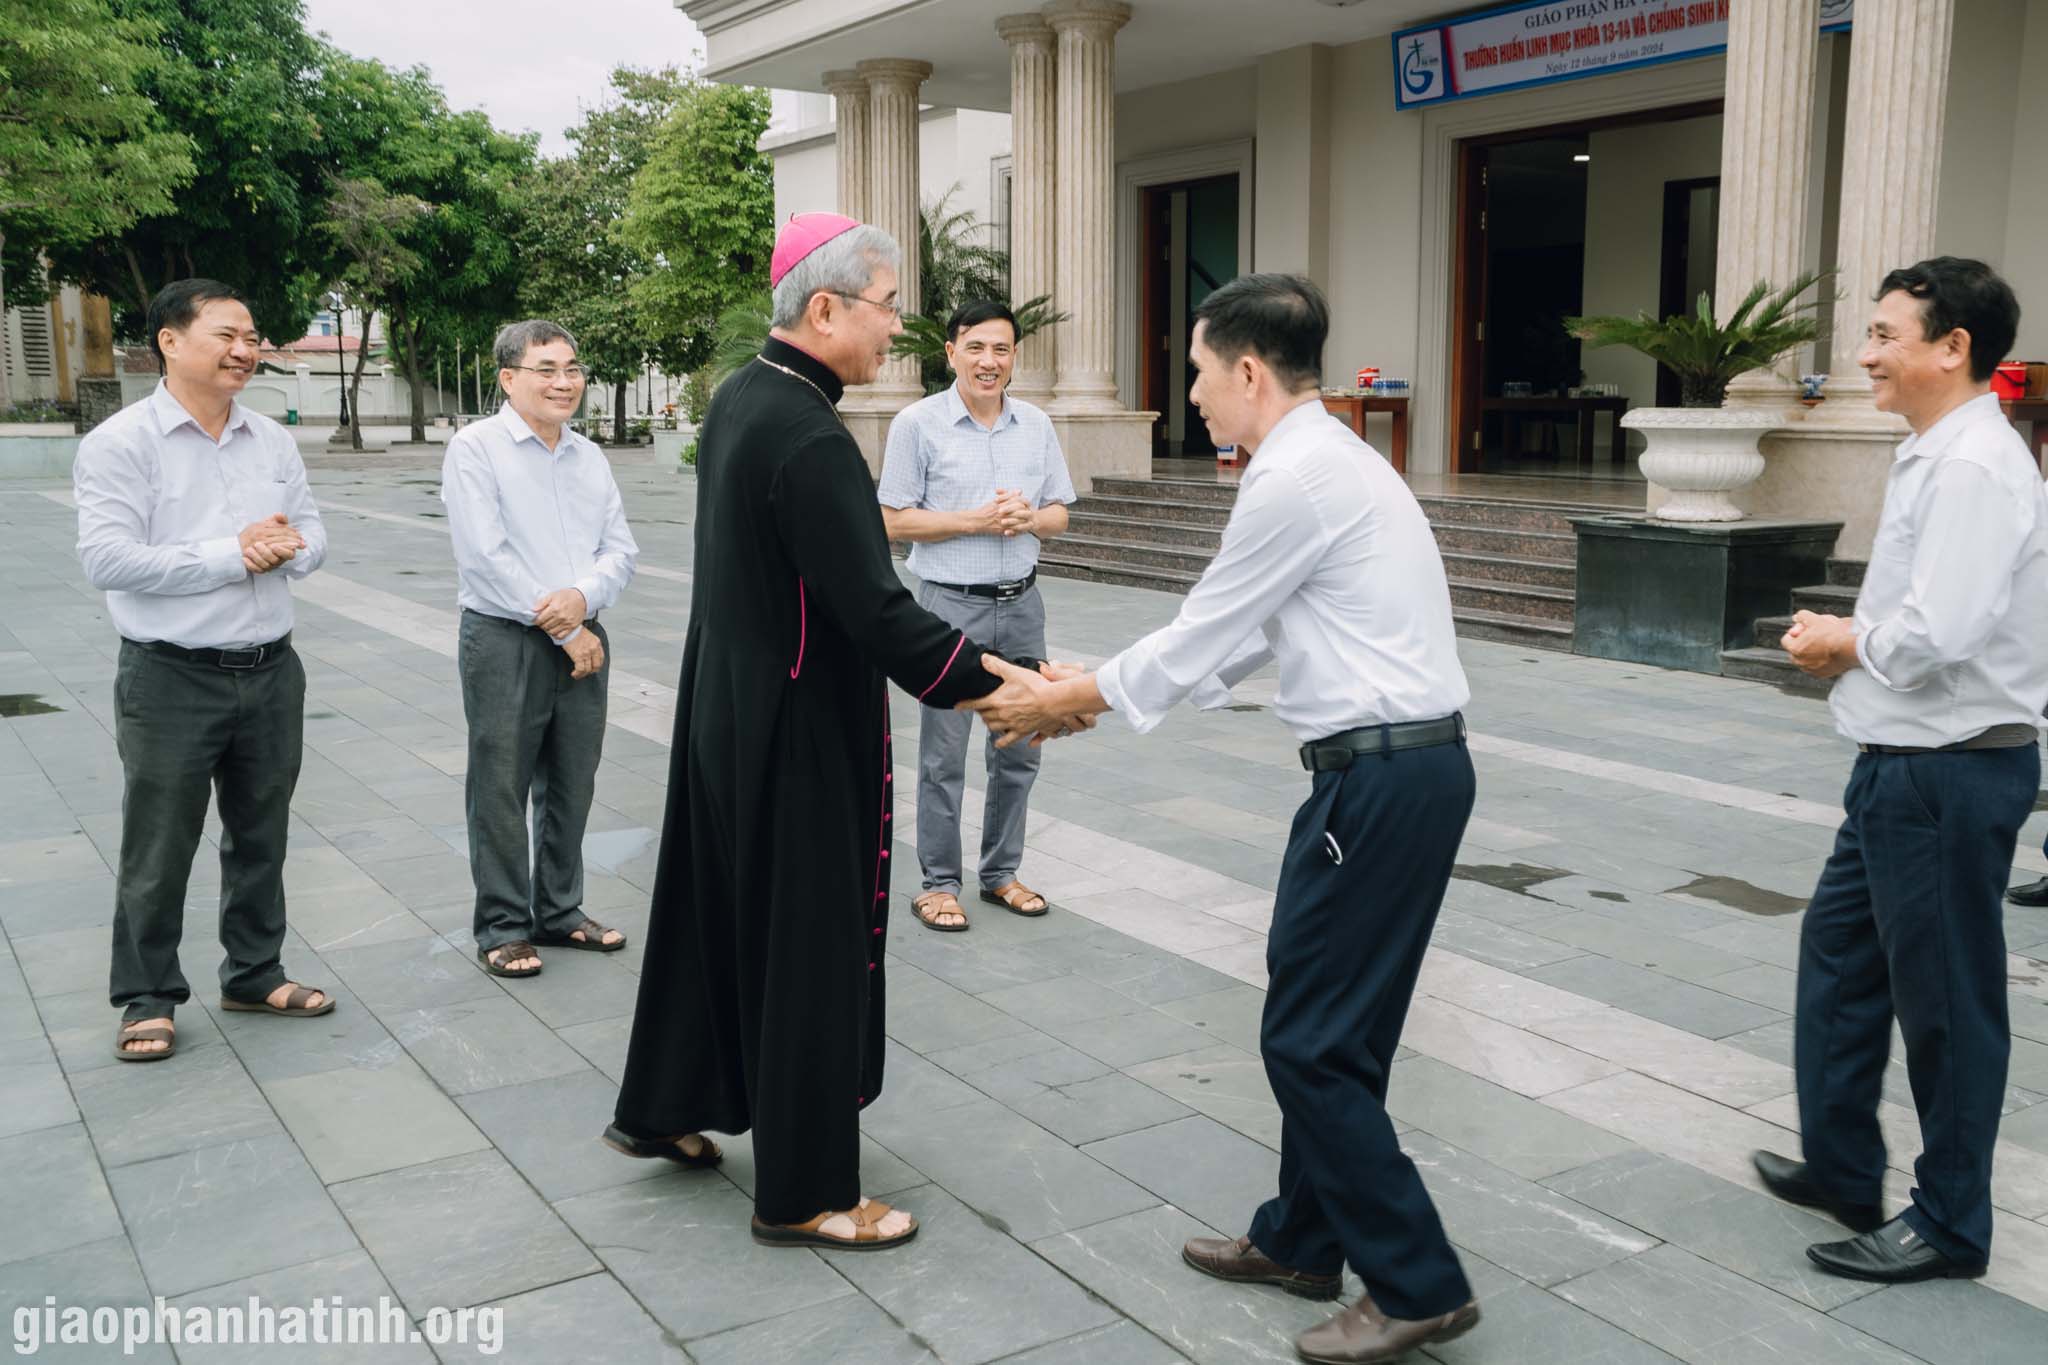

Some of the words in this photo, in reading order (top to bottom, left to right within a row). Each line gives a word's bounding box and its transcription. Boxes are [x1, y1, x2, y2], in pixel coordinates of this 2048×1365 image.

[1524, 8, 1562, 29] GIÁO
[1526, 35, 1548, 60] LINH
[1549, 31, 1572, 57] MỤC
[1574, 22, 1600, 49] KHÓA
[1602, 18, 1631, 43] 13-14
[1633, 11, 1648, 37] VÀ
[1687, 2, 1715, 27] SINH
[1570, 57, 1580, 69] 12
[1640, 42, 1664, 56] 2024
